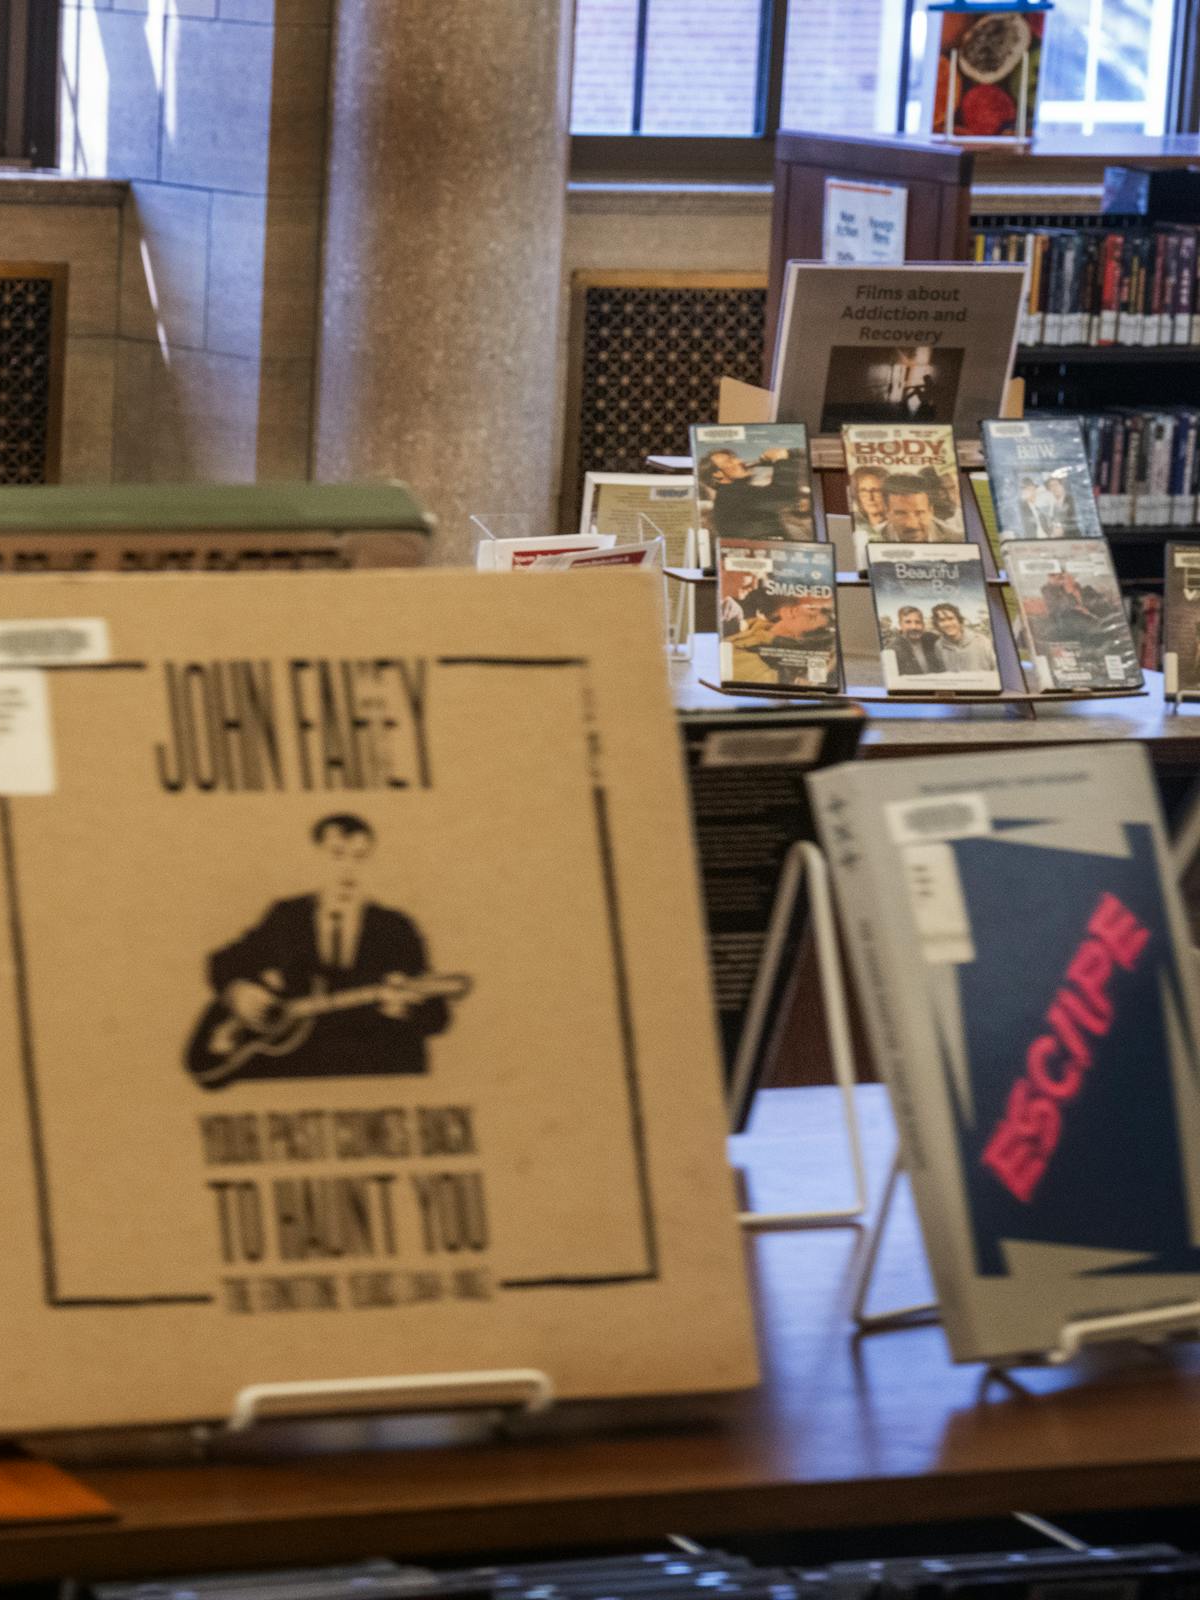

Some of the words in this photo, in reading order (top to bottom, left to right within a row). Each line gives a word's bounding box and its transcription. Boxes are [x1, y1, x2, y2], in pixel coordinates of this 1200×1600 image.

[855, 284, 902, 301] Films
[907, 286, 961, 301] about
[841, 305, 929, 322] Addiction
[932, 307, 968, 322] and
[858, 326, 944, 345] Recovery
[853, 439, 946, 456] BODY
[856, 455, 947, 466] BROKERS
[895, 562, 960, 580] Beautiful
[766, 579, 833, 599] SMASHED
[155, 656, 285, 793] JOHN
[290, 655, 433, 792] FAHEY
[207, 1179, 267, 1265] TO
[272, 1173, 400, 1262] HAUNT
[408, 1170, 491, 1257] YOU
